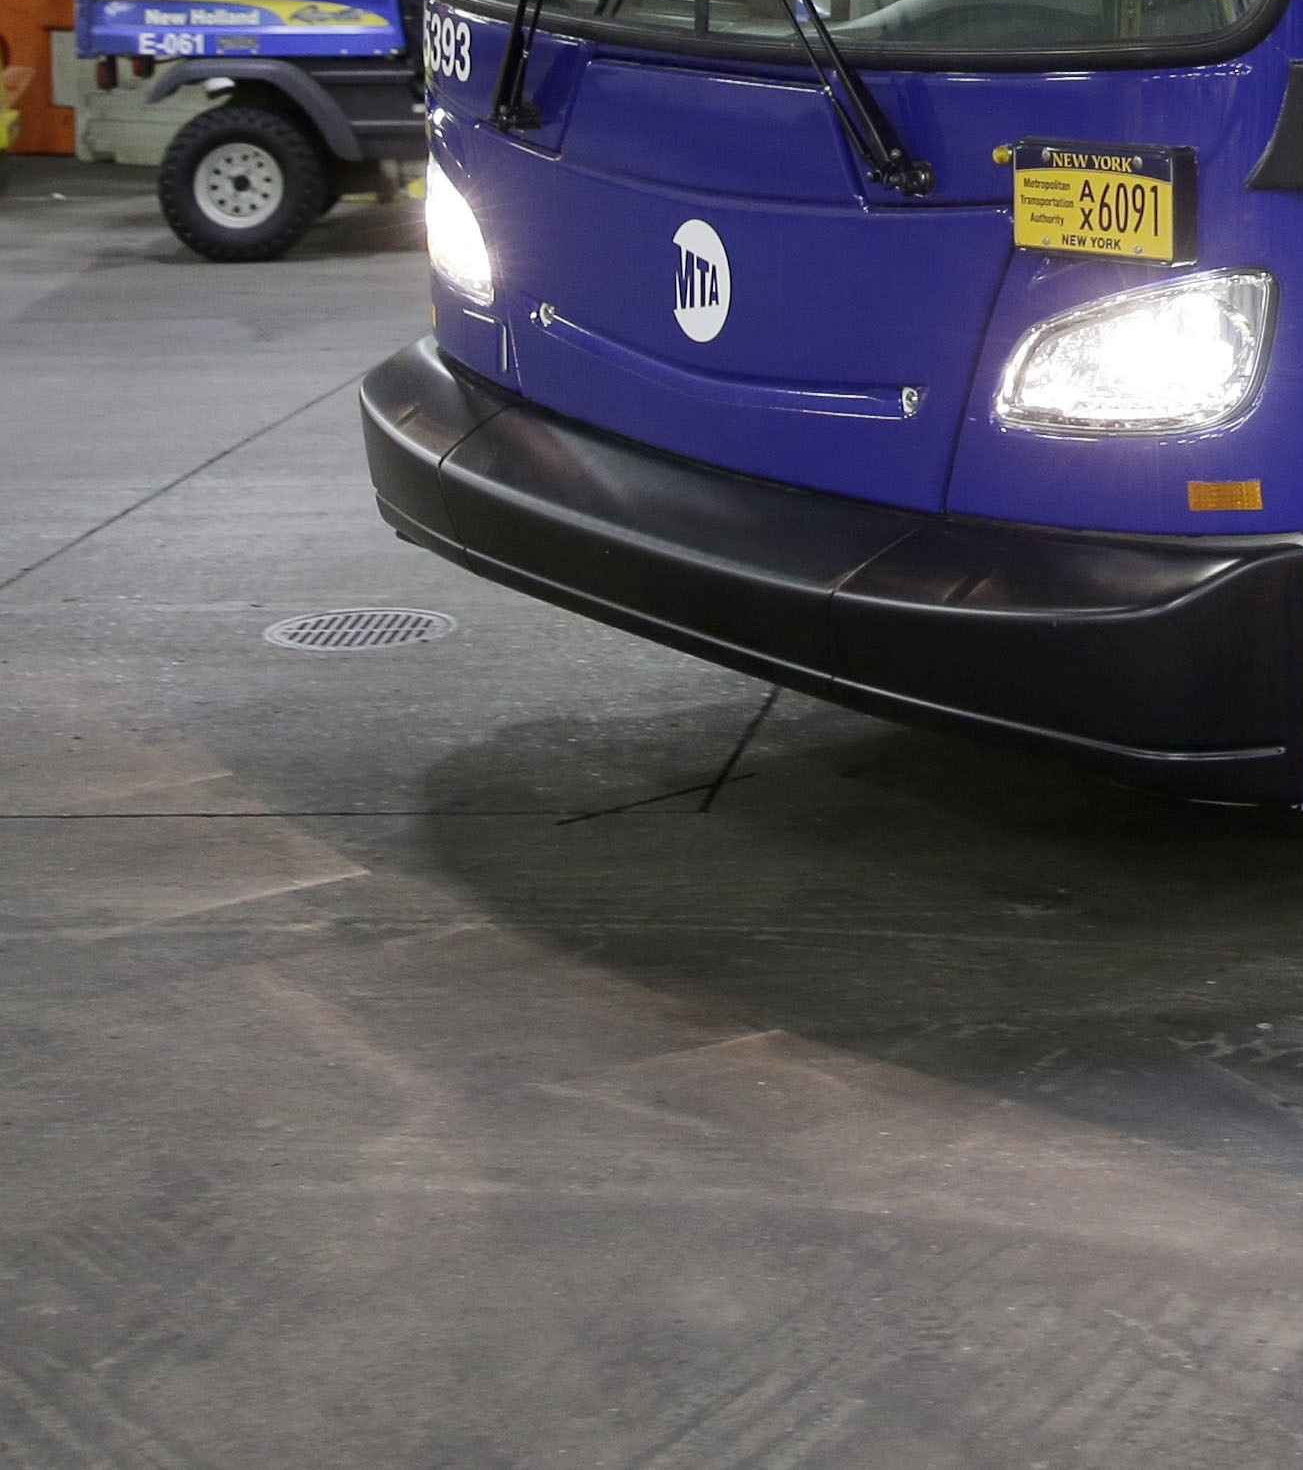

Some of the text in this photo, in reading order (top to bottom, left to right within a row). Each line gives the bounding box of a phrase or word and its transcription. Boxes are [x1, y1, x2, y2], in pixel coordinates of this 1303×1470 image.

[145, 8, 260, 26] New Holland
[138, 33, 205, 56] E-061
[423, 10, 471, 82] 5393
[1052, 152, 1133, 173] NEW YORK
[1023, 178, 1071, 192] Metropolitan
[1020, 193, 1074, 209] Transportation
[1099, 182, 1159, 237] 6091
[1030, 212, 1064, 227] Authority
[1061, 234, 1121, 251] NEW YORK
[674, 245, 720, 311] MTA
